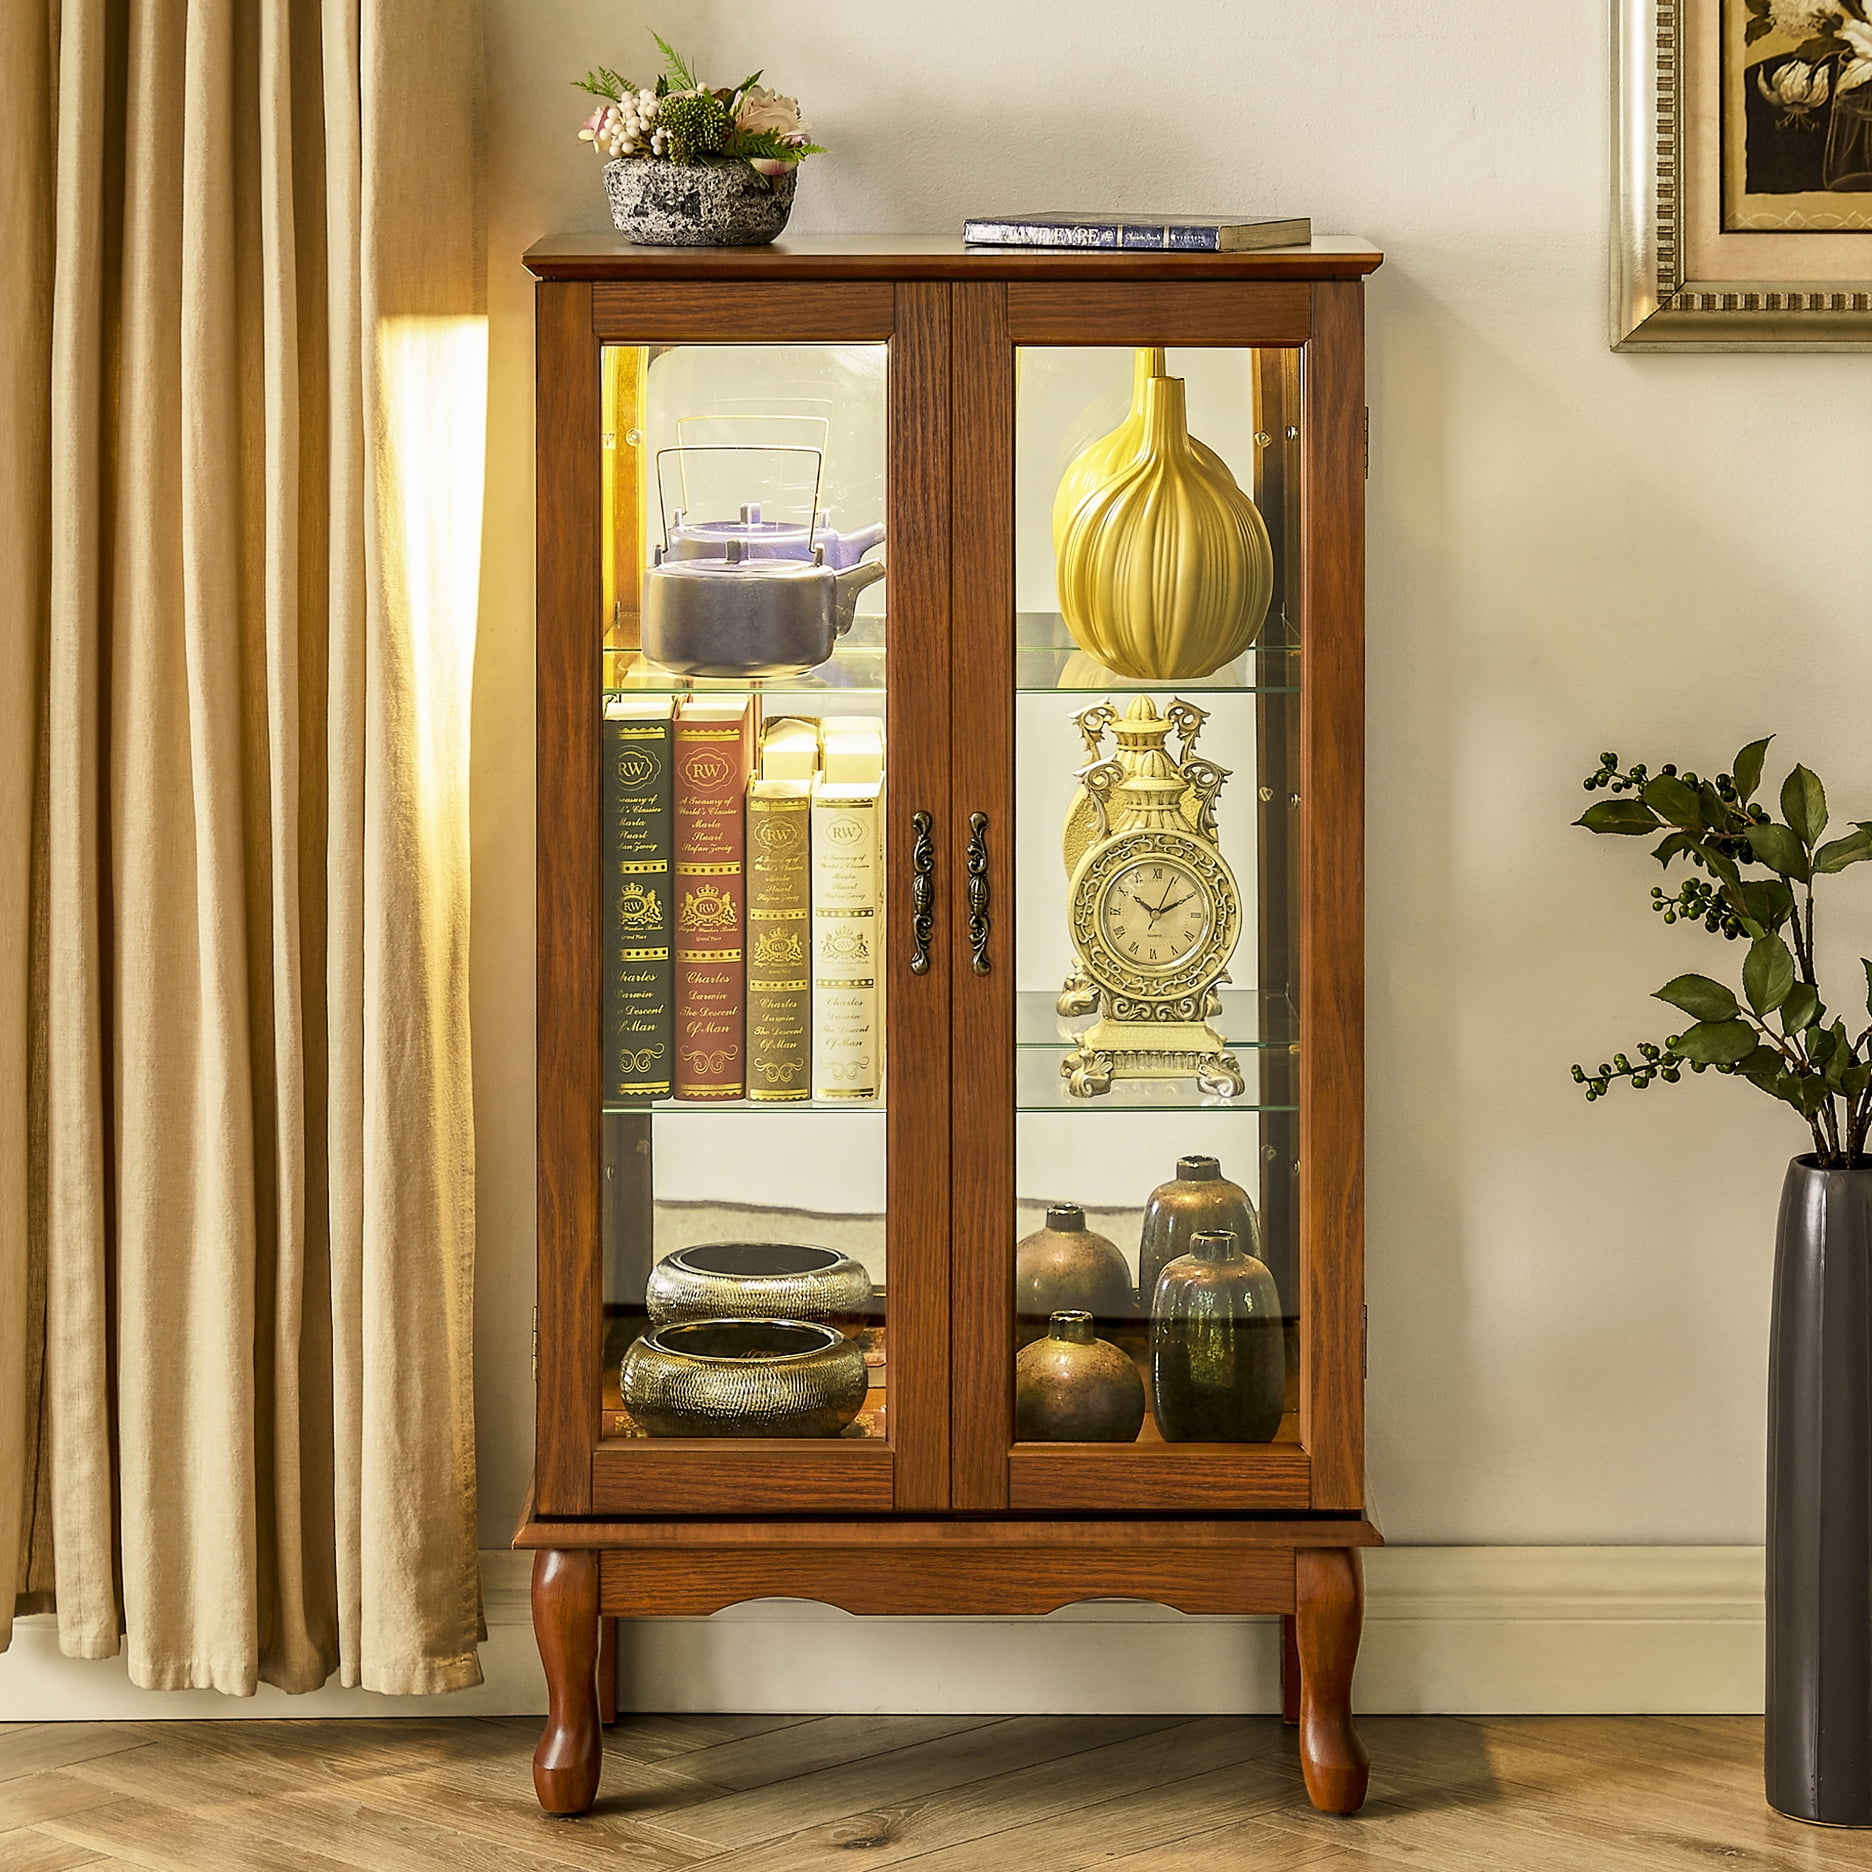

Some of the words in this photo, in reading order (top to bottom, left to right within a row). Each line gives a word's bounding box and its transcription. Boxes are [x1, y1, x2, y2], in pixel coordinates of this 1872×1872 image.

[1054, 228, 1098, 246] EYRE
[618, 762, 644, 776] RW
[693, 764, 721, 779] RW
[648, 794, 658, 805] of
[724, 796, 734, 806] of
[767, 829, 790, 841] RW
[833, 828, 856, 838] RW
[1153, 869, 1162, 879] XII
[1118, 887, 1128, 896] X
[624, 902, 642, 912] RW
[699, 904, 716, 913] RW
[1110, 907, 1121, 915] IX
[1114, 925, 1126, 940] VIII
[771, 942, 786, 951] RW
[1128, 941, 1139, 955] VII
[1171, 945, 1178, 955] V
[1150, 949, 1157, 960] VI
[617, 970, 659, 982] harles
[686, 971, 732, 984] Charles
[688, 990, 728, 1000] Darwin
[760, 999, 798, 1008] Charles
[680, 1007, 697, 1016] The
[700, 1006, 737, 1016] Descent
[628, 1020, 658, 1032] Man
[686, 1021, 701, 1037] Of
[701, 1022, 730, 1033] Man
[754, 1026, 770, 1035] The
[772, 1026, 803, 1035] Descent
[760, 1039, 773, 1052] Of
[773, 1039, 797, 1048] Man
